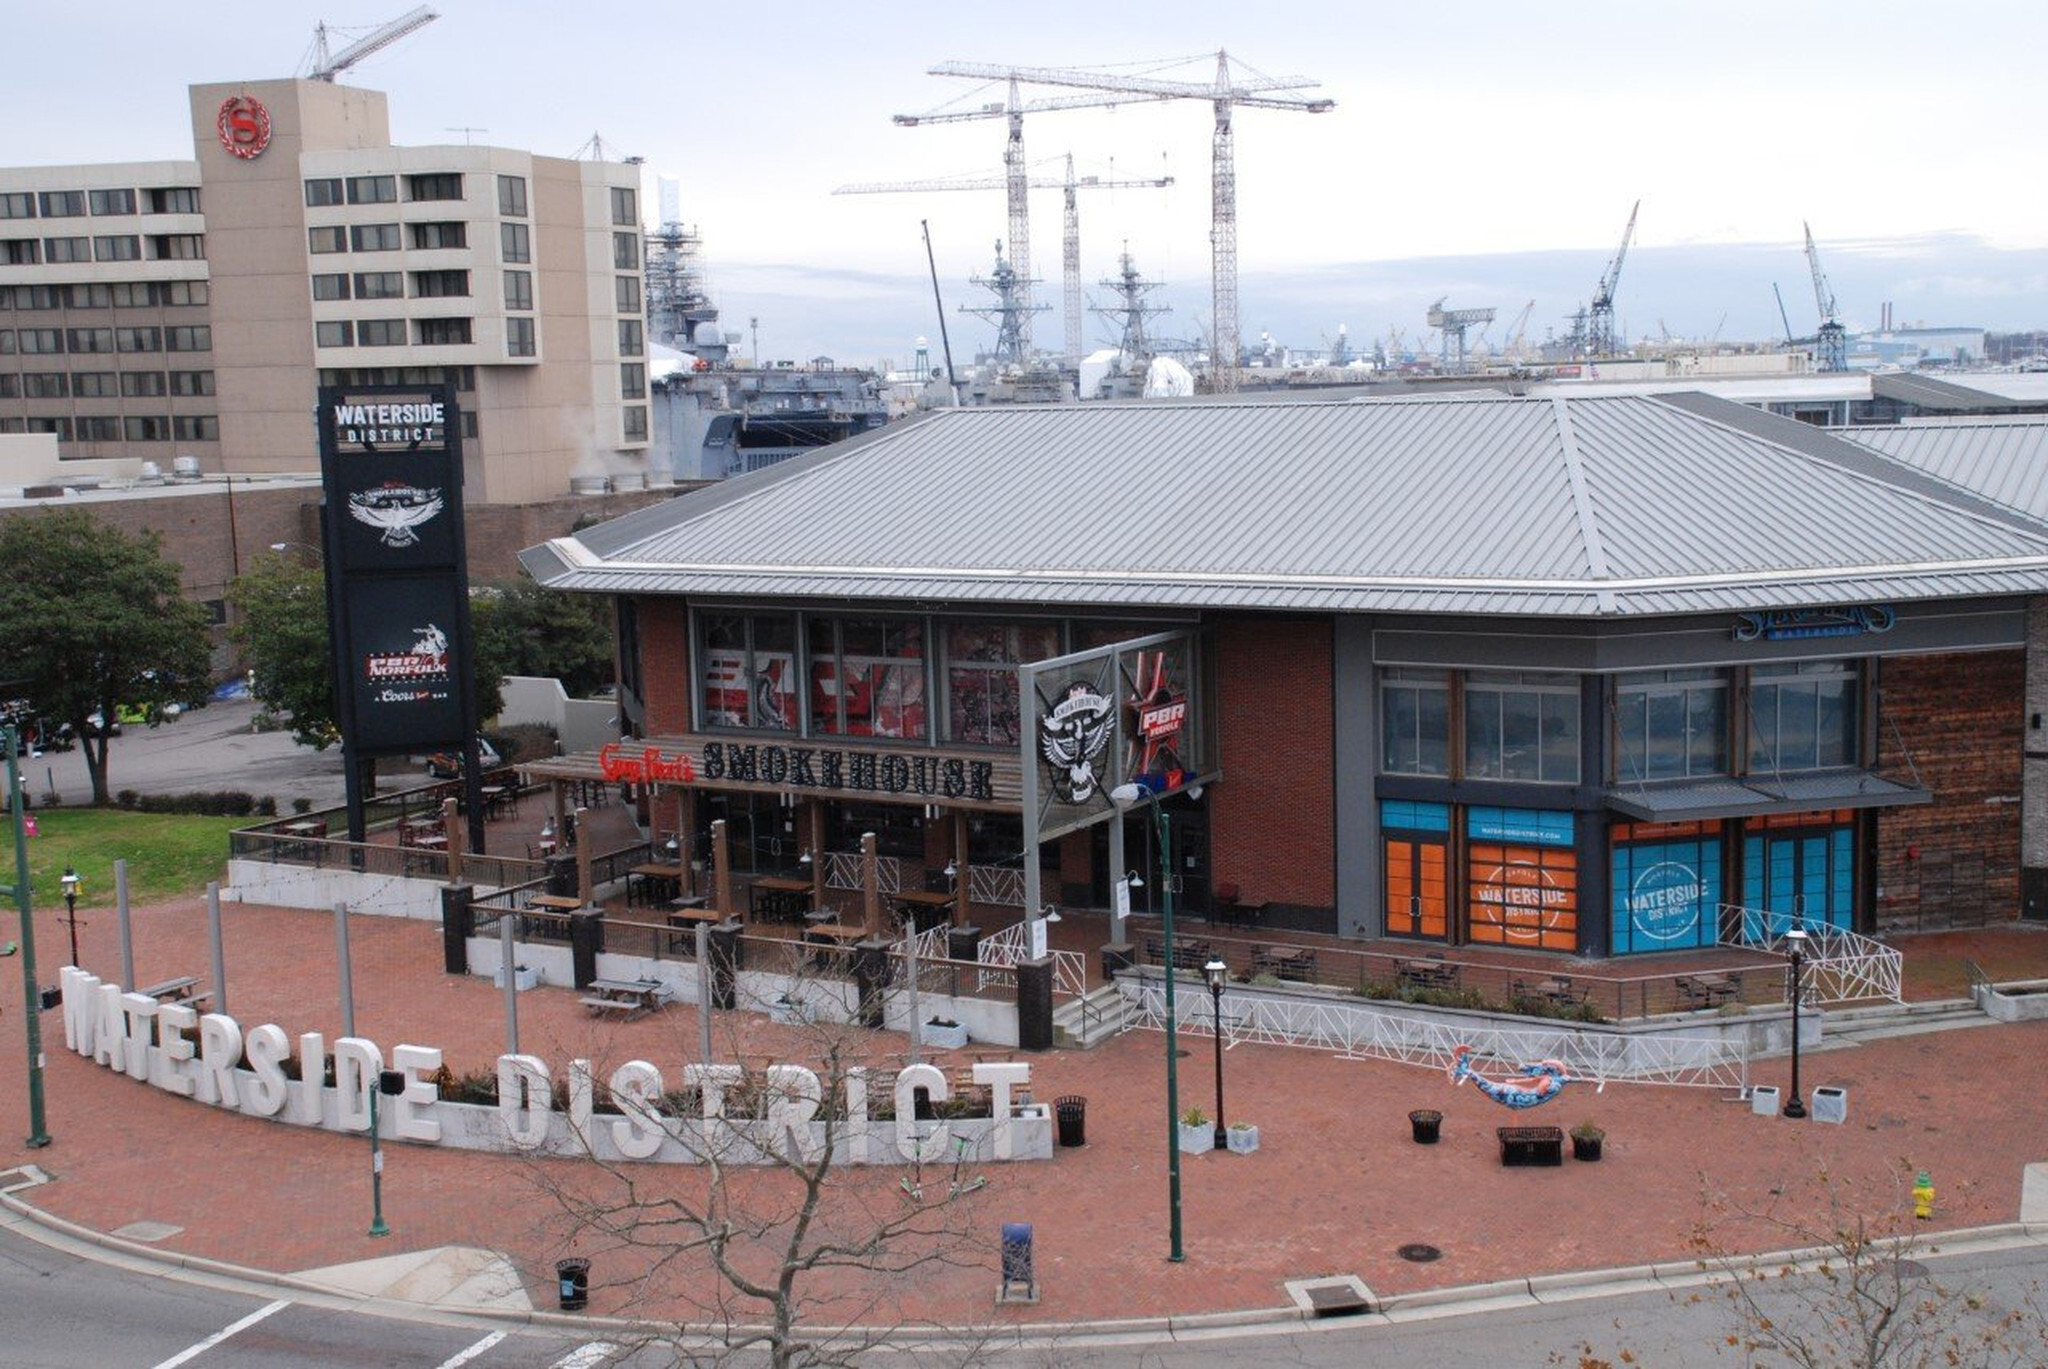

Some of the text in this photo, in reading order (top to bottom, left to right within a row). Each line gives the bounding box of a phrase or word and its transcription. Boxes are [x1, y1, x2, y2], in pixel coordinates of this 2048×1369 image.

[229, 106, 257, 144] S
[335, 403, 445, 425] WATERSIDE
[347, 428, 433, 442] DISTRICT
[369, 663, 447, 676] NORFOLK
[381, 689, 415, 702] Coors
[1143, 703, 1185, 730] PBR
[704, 741, 993, 799] SMOKEHOUSE
[1478, 885, 1568, 905] WATERSIDE
[1624, 879, 1709, 914] WATERSIDE
[60, 966, 1031, 1162] WATERSIDE DISTRICT
